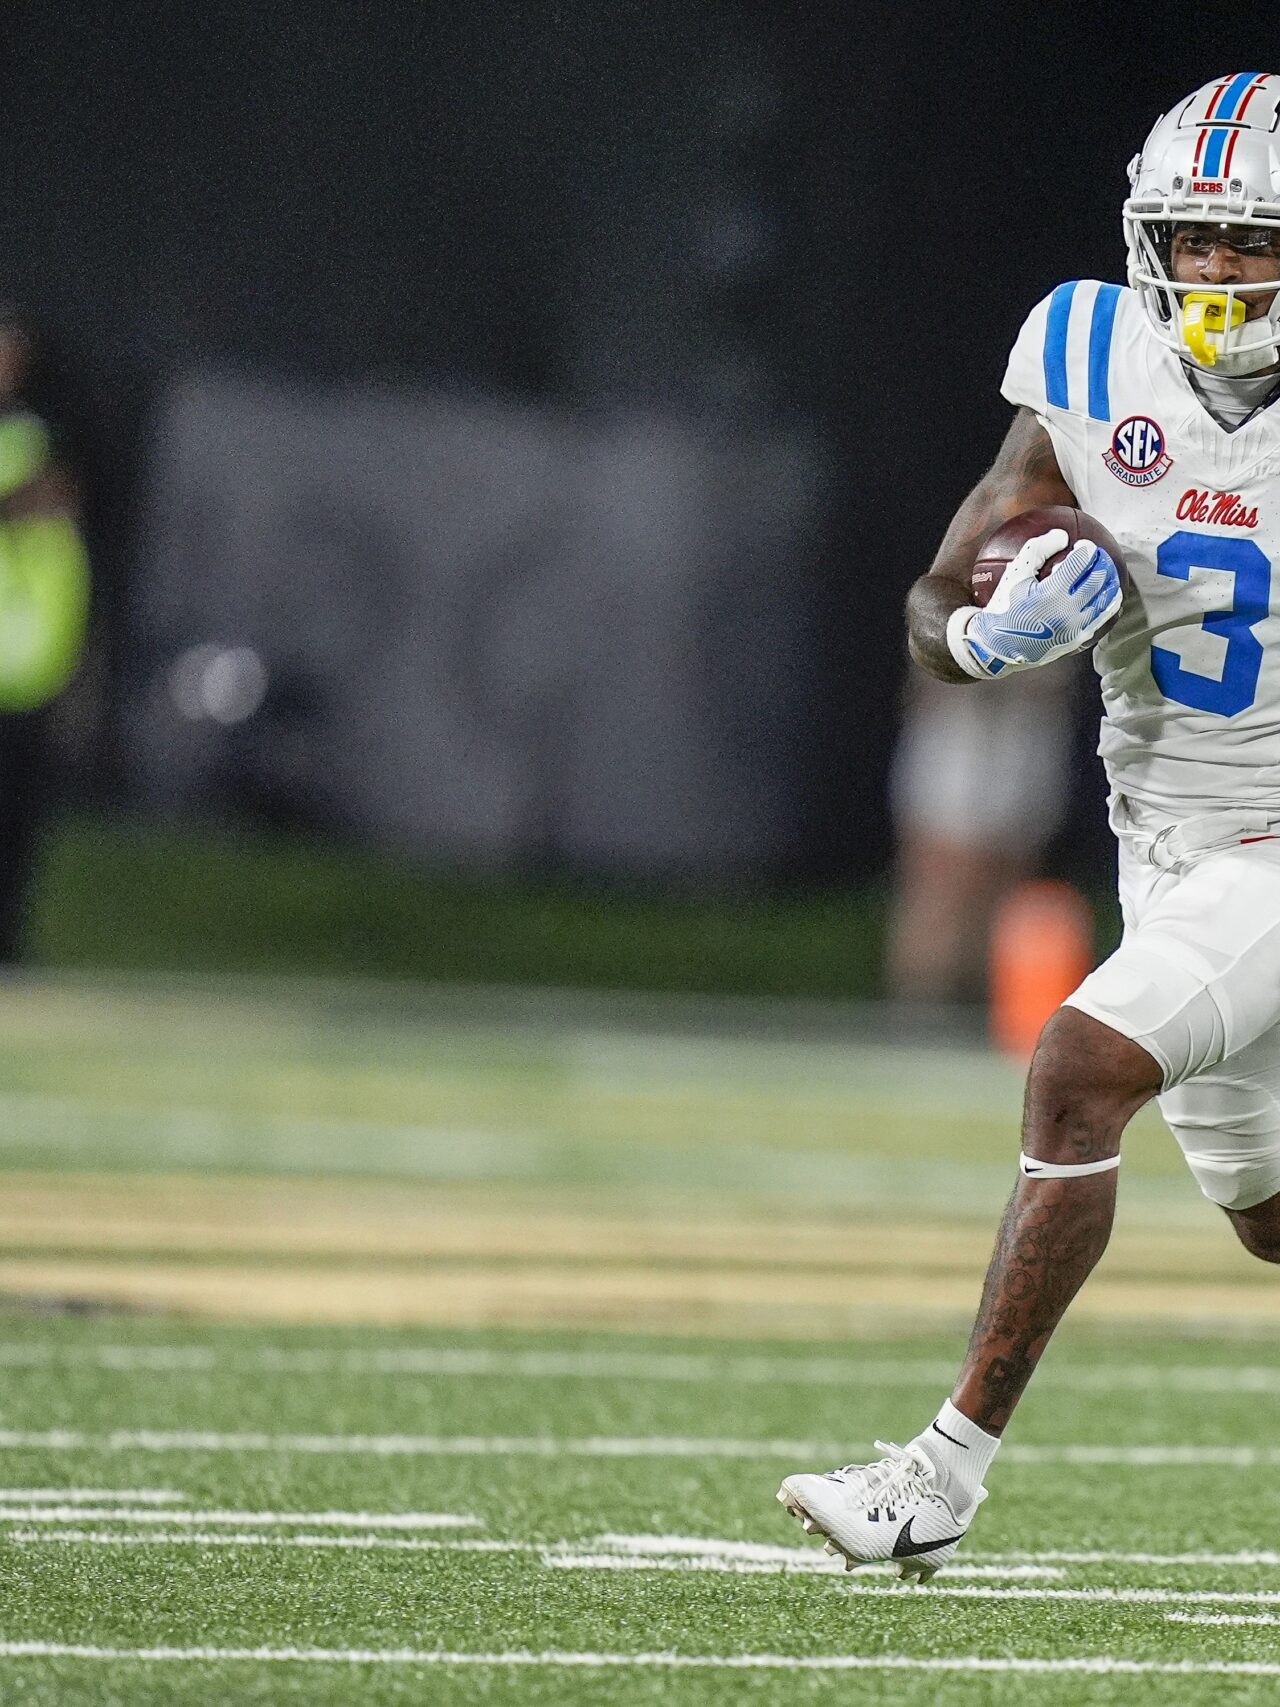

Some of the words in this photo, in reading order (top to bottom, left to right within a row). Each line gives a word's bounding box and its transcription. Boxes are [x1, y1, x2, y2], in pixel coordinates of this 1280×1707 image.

[1193, 182, 1223, 193] REBS
[1117, 420, 1160, 468] SEC
[1110, 461, 1162, 484] GRADUATE
[1176, 489, 1209, 522] Ole
[1207, 491, 1259, 528] Miss
[1151, 530, 1271, 717] 3
